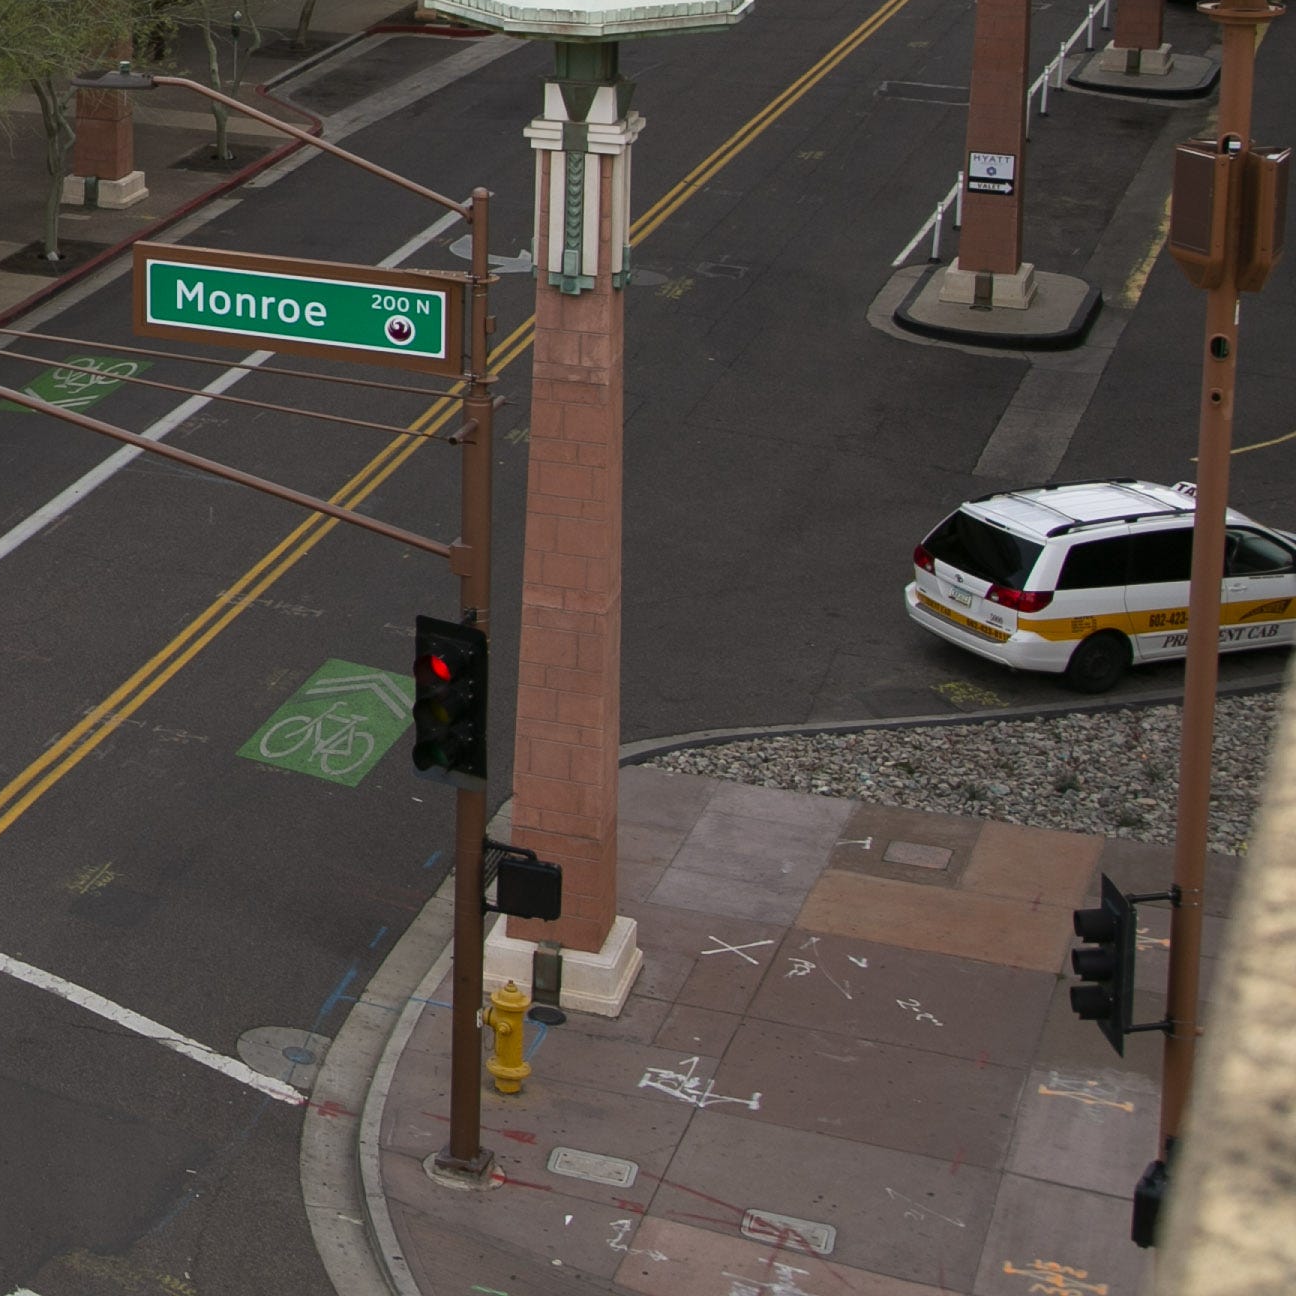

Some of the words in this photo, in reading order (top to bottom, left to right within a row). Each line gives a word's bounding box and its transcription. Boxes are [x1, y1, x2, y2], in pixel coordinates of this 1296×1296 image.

[973, 155, 1011, 164] HYATT
[175, 279, 328, 327] Monroe
[370, 294, 410, 313] 200
[415, 299, 431, 316] N
[1247, 624, 1280, 640] CAB
